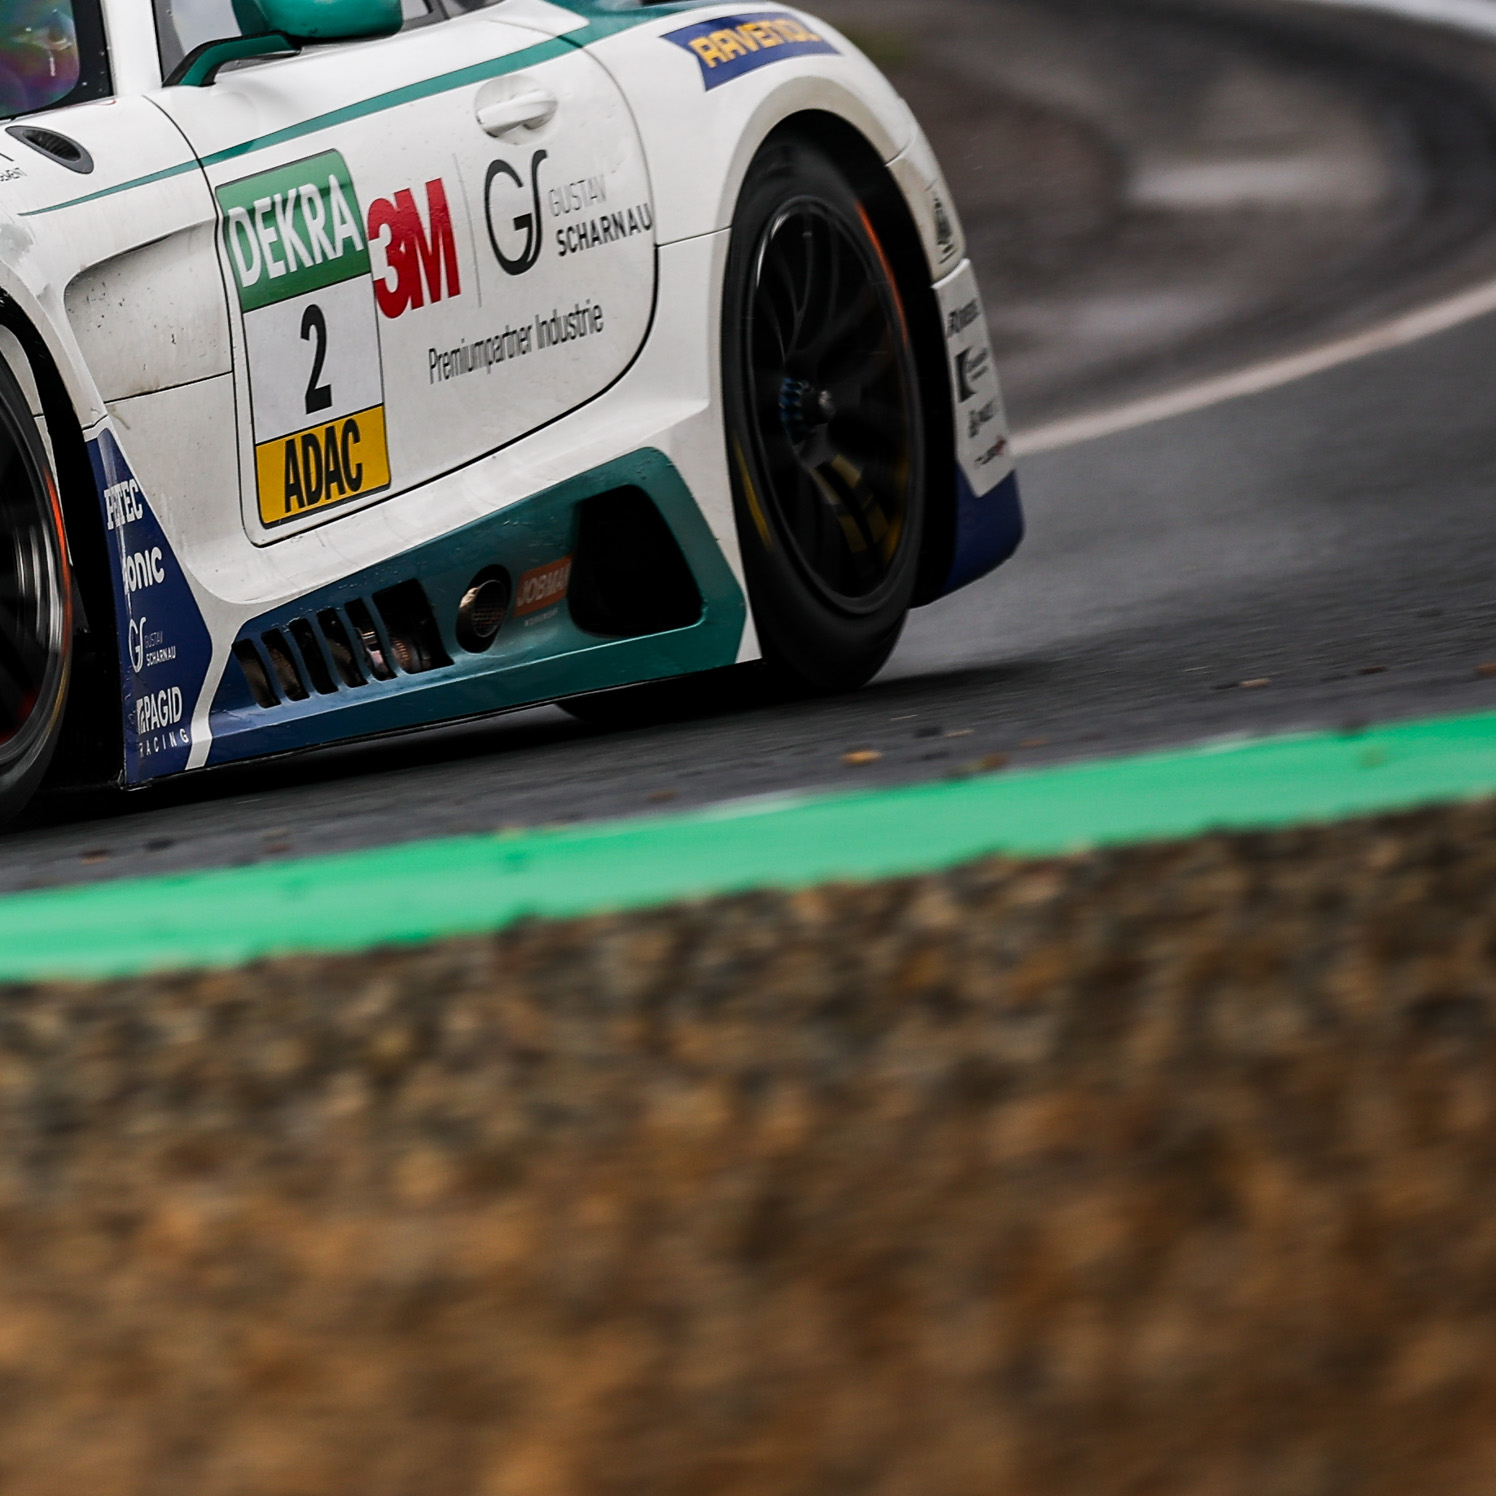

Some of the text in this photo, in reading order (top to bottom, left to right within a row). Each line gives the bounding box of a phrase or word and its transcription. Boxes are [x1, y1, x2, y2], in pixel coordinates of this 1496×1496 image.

[548, 173, 608, 217] GUSTAV
[557, 202, 653, 257] SCHARNAU
[227, 173, 365, 289] DEKRA
[367, 177, 462, 320] 3M
[300, 304, 333, 415] 2
[428, 299, 605, 385] Premiumpartner Industrie
[283, 418, 364, 514] ADAC
[146, 645, 176, 667] SCHARNAU
[139, 728, 189, 758] RACING
[143, 686, 183, 733] PAGID
